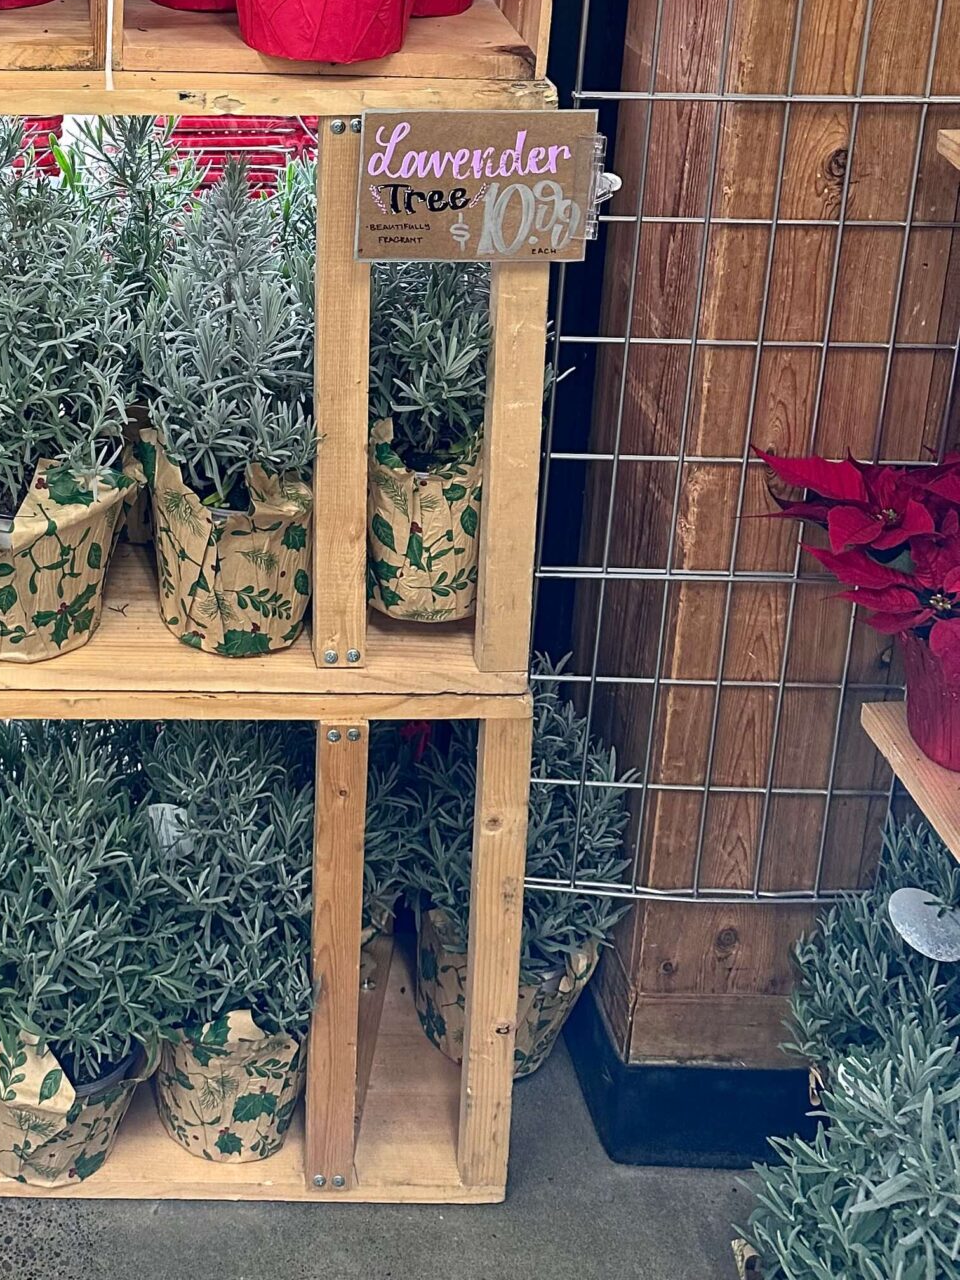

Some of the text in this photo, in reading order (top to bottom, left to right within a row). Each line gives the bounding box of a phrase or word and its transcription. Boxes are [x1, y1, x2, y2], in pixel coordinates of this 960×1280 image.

[368, 122, 571, 180] Lavender
[378, 183, 471, 215] Tree
[378, 236, 423, 244] FRAGRANT
